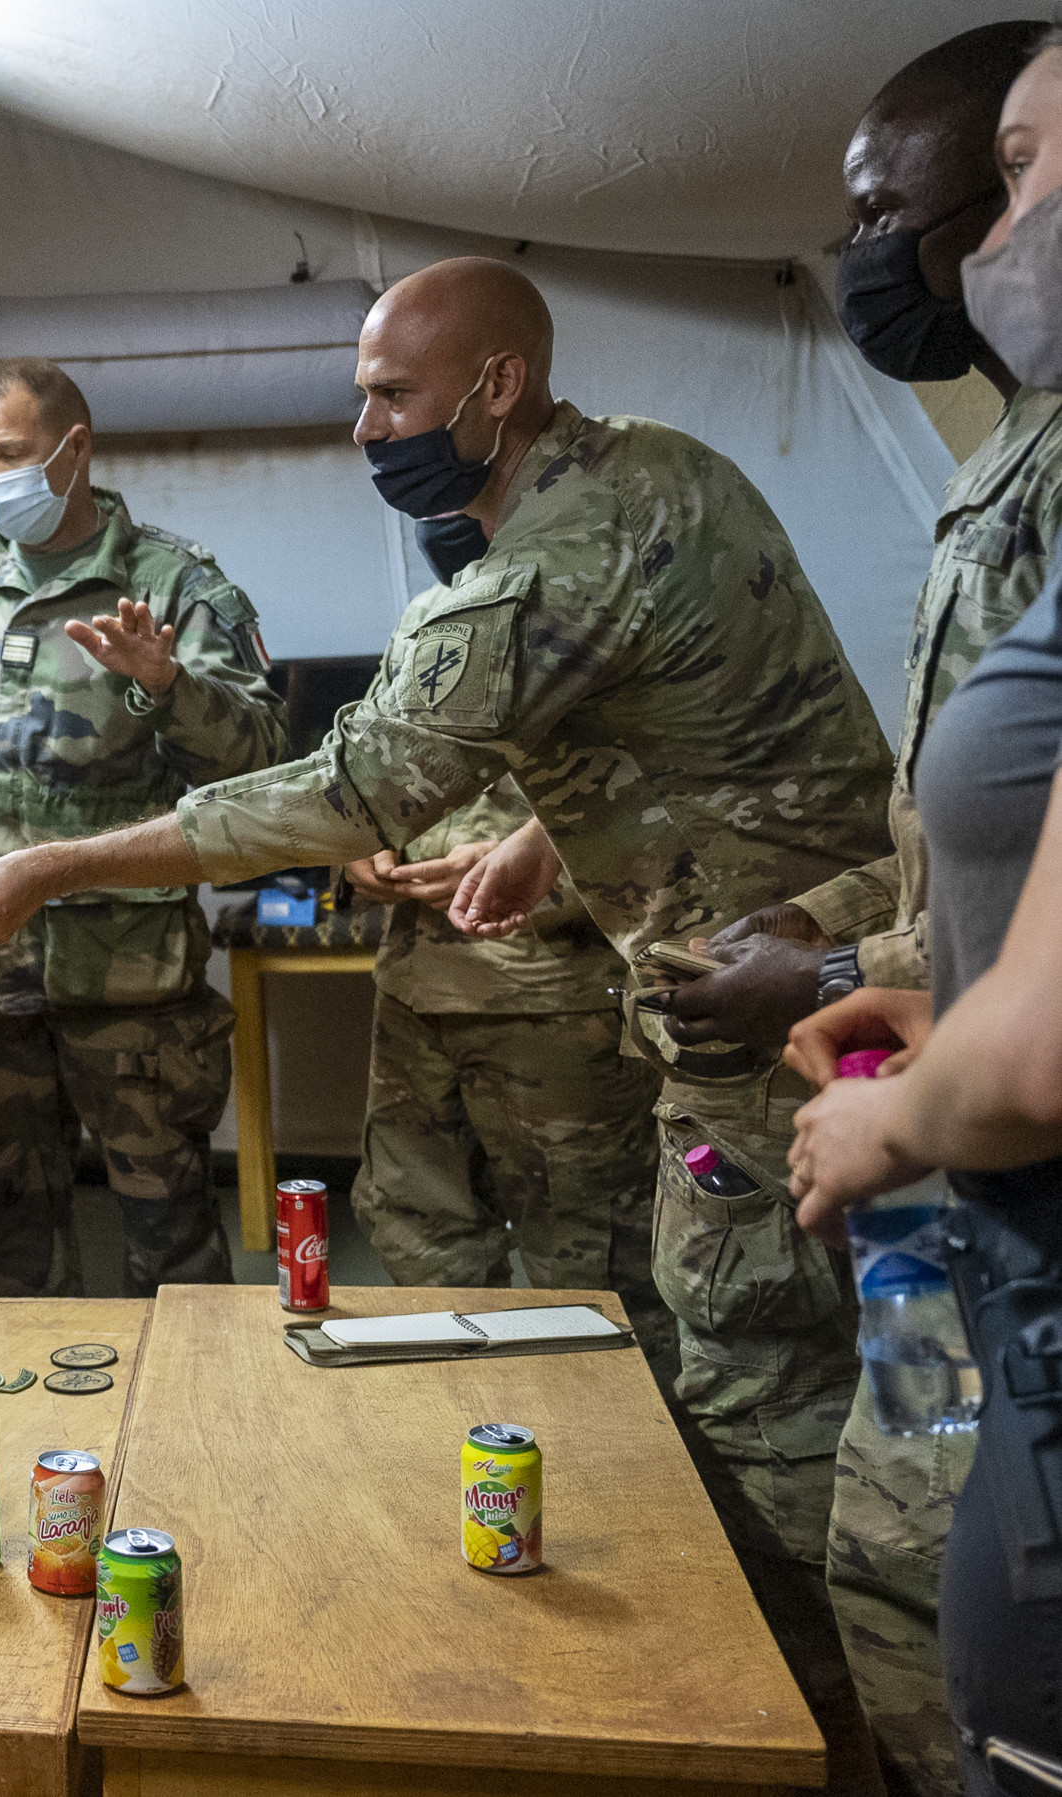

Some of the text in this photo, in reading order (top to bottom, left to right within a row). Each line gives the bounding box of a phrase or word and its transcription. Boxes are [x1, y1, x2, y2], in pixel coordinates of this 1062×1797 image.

[423, 624, 469, 637] AIRBORNE
[51, 1488, 76, 1505] Liela
[465, 1484, 526, 1513] Mango
[48, 1508, 80, 1520] SUMO DE
[483, 1511, 509, 1523] juice
[40, 1507, 99, 1540] Laranja
